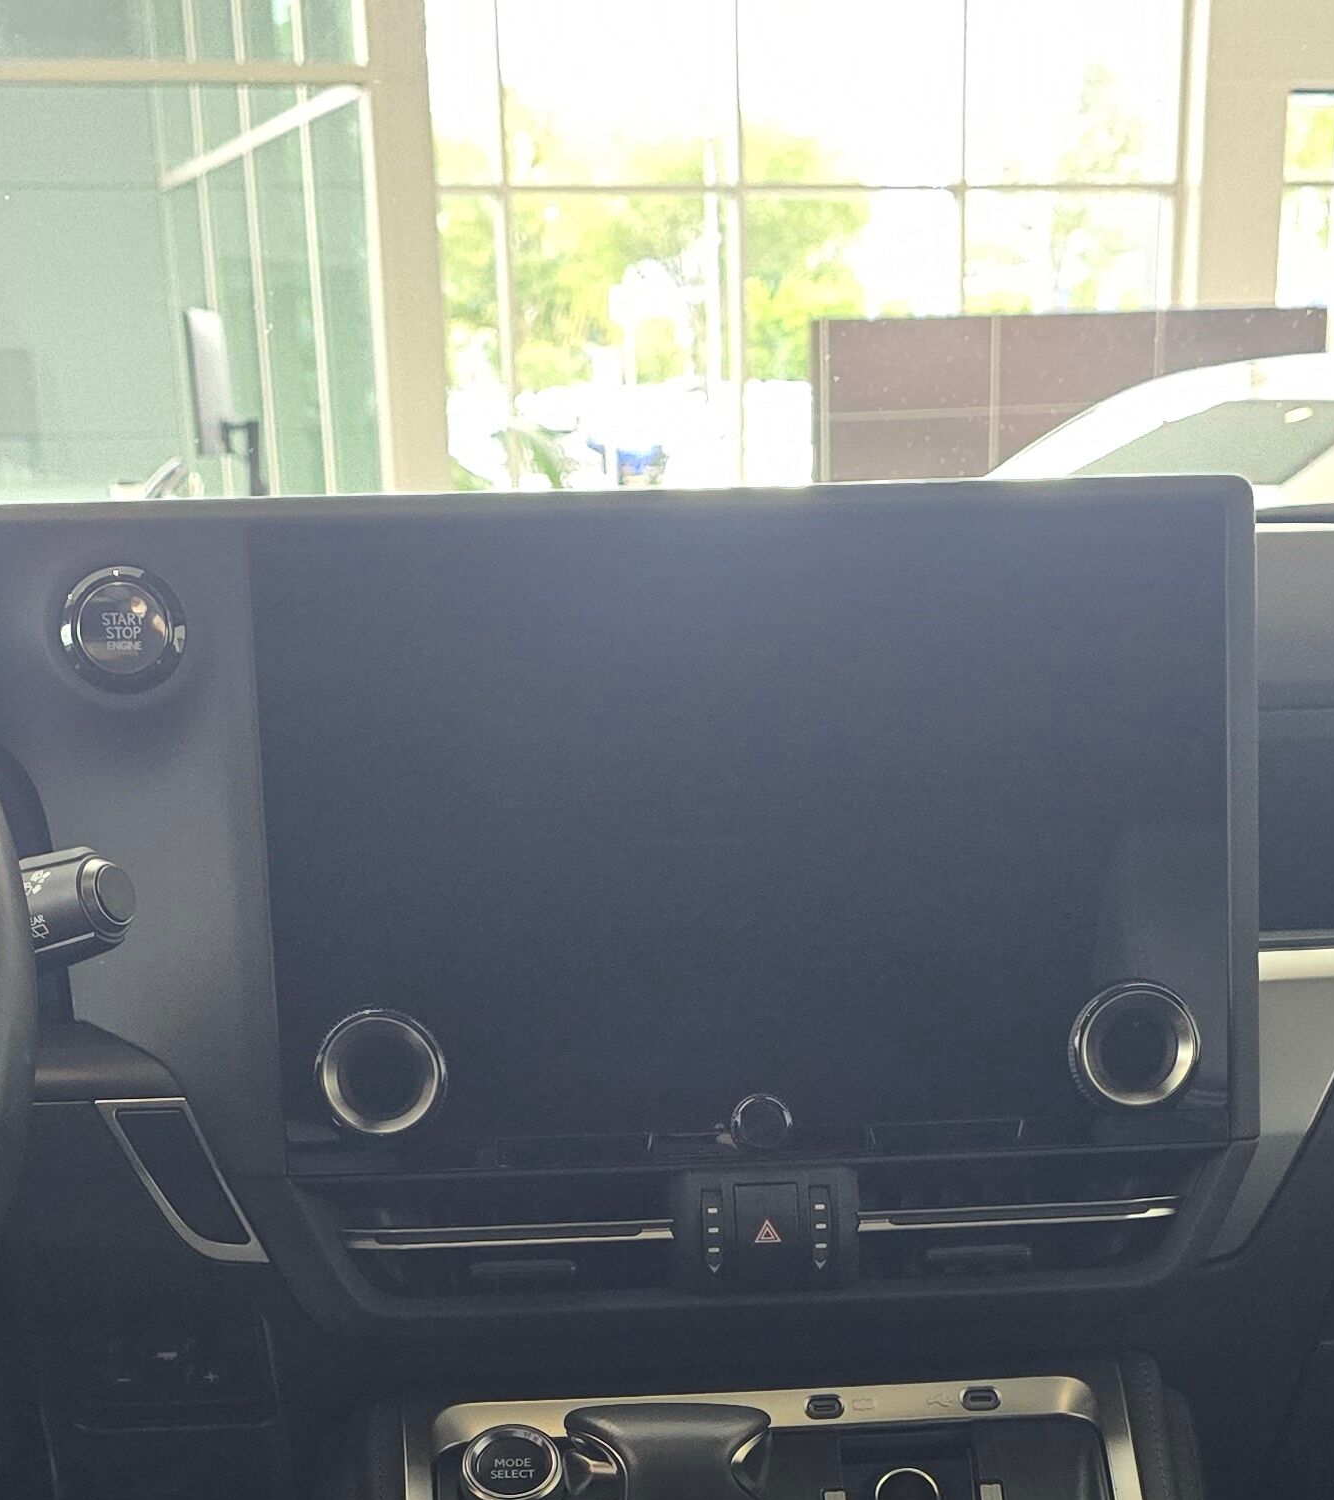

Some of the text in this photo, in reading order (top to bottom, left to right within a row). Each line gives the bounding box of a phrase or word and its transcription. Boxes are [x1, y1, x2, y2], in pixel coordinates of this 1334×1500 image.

[101, 612, 143, 626] START
[105, 626, 142, 640] STOP
[106, 640, 143, 650] ENGINE
[494, 1457, 532, 1468] MODE
[490, 1469, 535, 1480] SELECT
